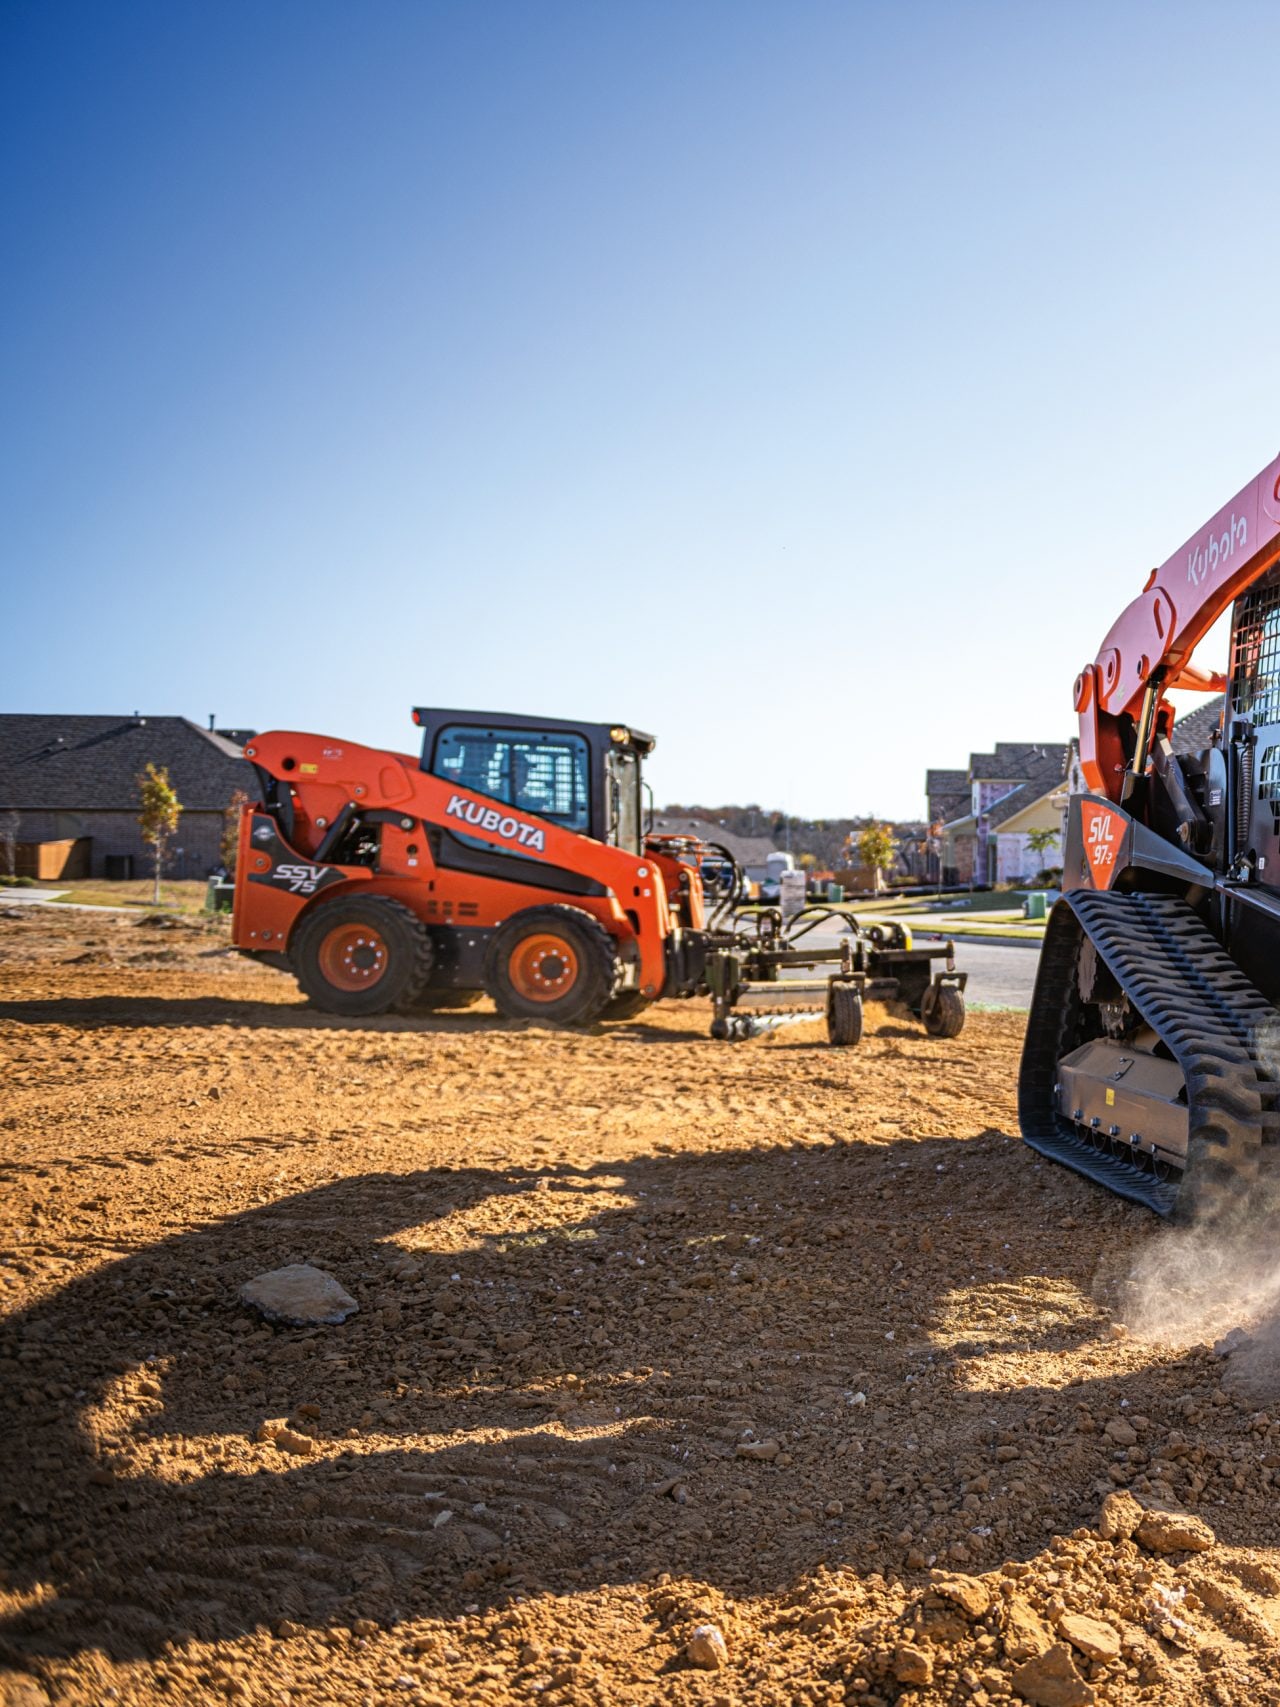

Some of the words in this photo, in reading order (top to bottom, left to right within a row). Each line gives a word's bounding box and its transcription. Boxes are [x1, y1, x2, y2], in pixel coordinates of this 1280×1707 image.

[1187, 512, 1247, 586] Kubota
[446, 795, 545, 852] KUBOTA
[1088, 815, 1114, 843] SVL
[1093, 844, 1113, 865] 97-2
[272, 864, 329, 880] SSV
[289, 879, 317, 893] 75
